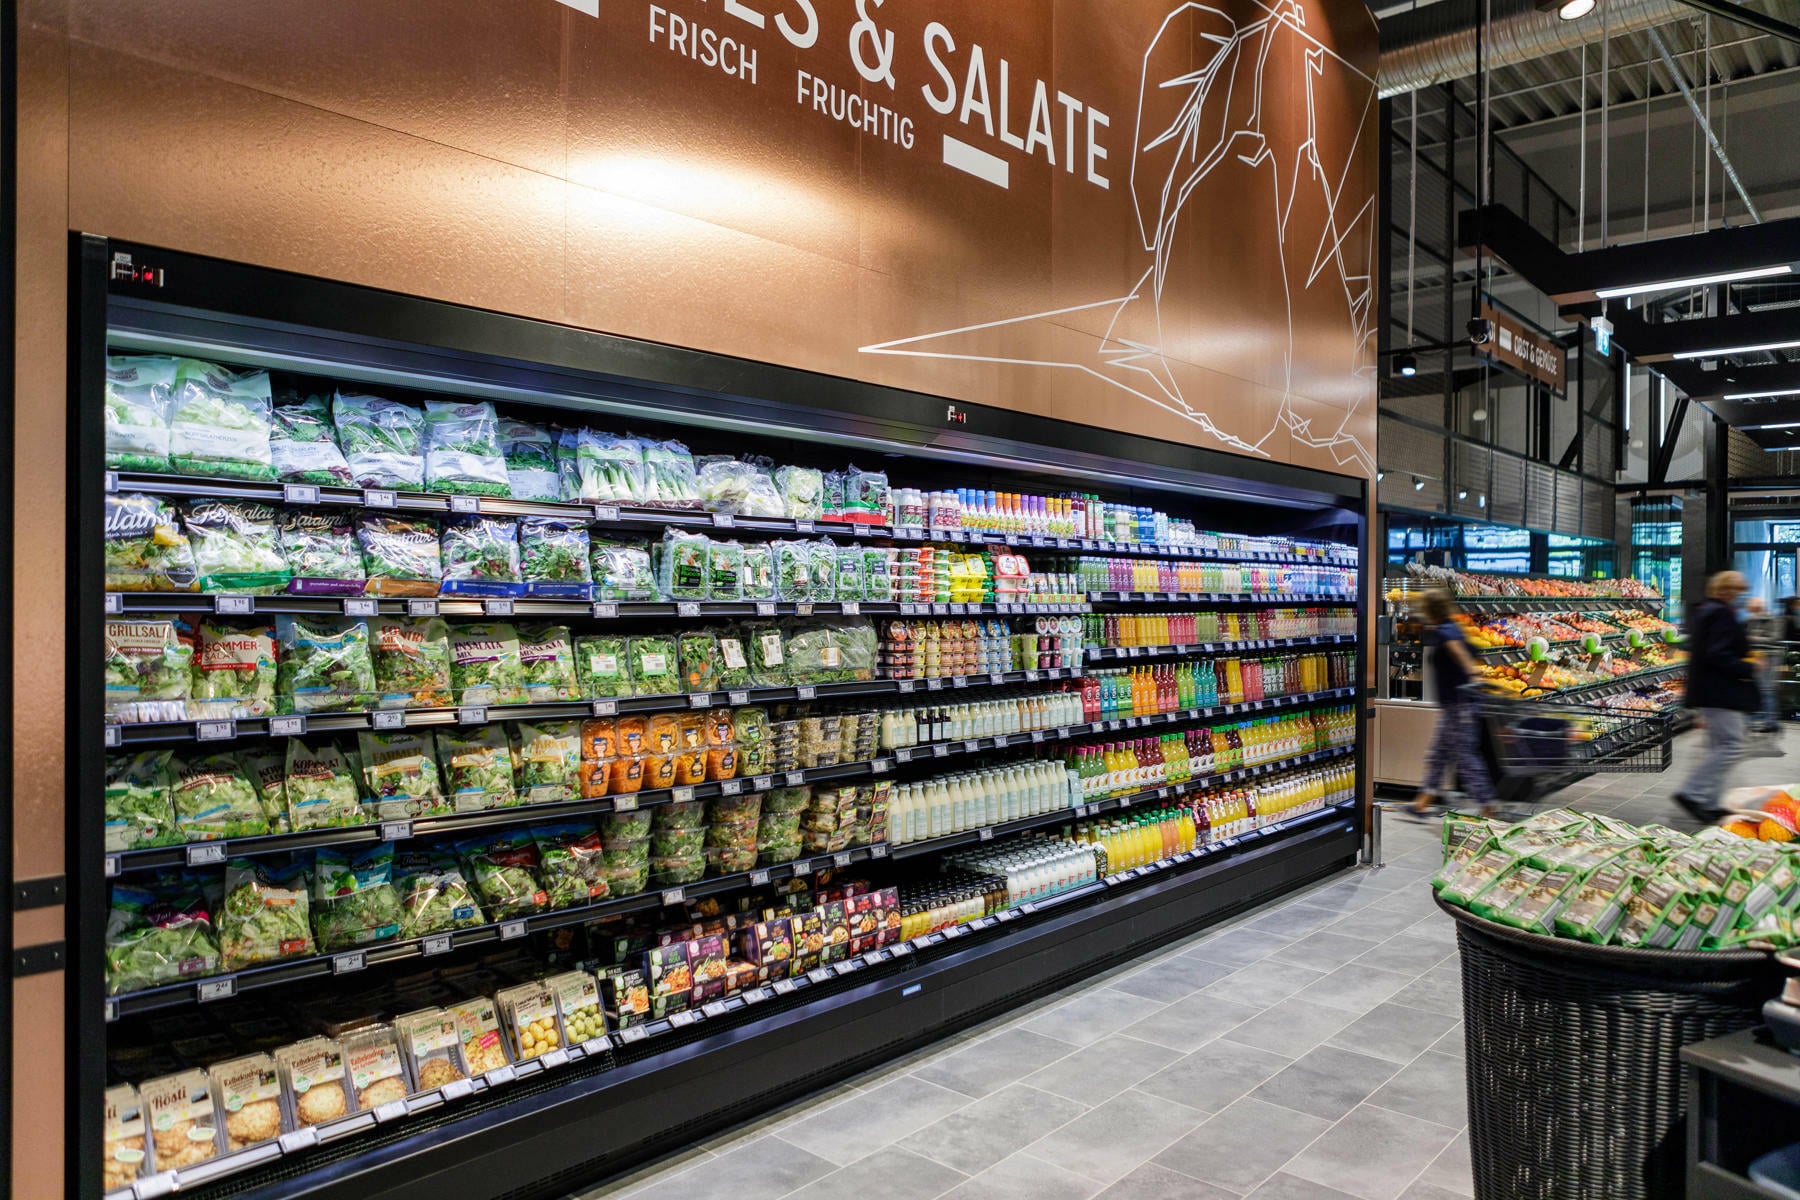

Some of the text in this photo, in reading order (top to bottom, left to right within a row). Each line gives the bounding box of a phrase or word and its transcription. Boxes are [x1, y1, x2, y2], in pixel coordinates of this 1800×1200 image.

[650, 4, 757, 84] FRISCH
[797, 69, 915, 149] FRUCHTIG
[849, 0, 1110, 190] & SALATE
[1514, 335, 1558, 375] OBST & GEMÜSE
